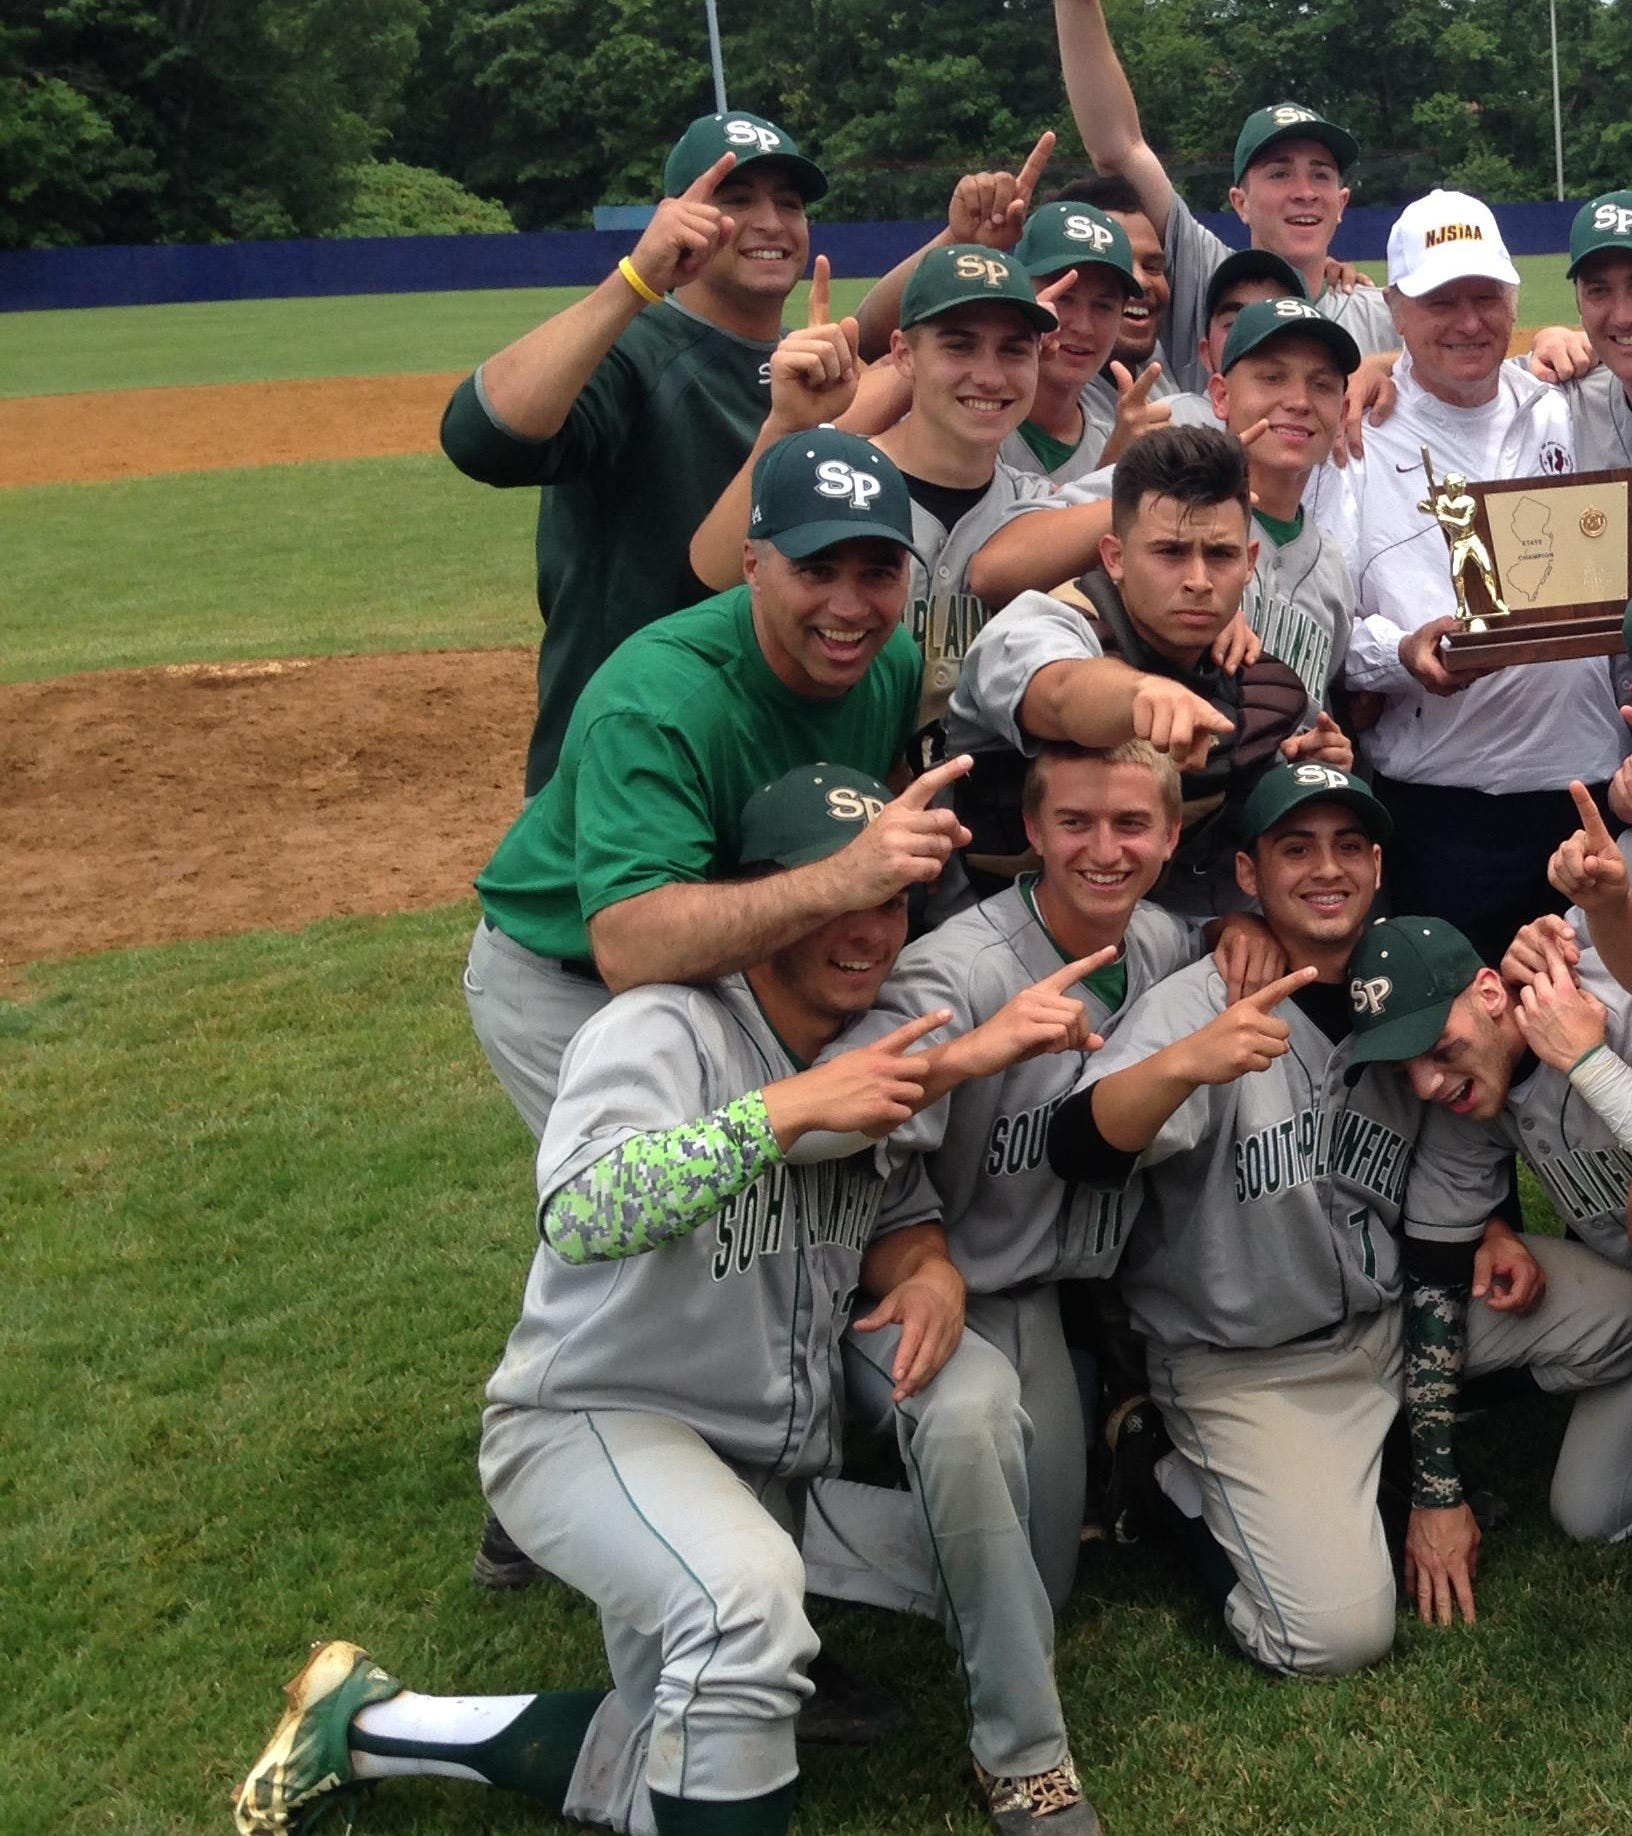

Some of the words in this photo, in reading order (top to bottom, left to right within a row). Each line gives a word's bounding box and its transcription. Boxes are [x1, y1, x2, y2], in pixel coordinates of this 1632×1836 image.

[725, 118, 782, 152] SP
[1064, 214, 1115, 254] SP
[1425, 223, 1483, 249] NJSIAA
[954, 253, 1010, 288] SP
[814, 460, 882, 511] SP
[1294, 763, 1349, 789] SP
[1349, 975, 1393, 1017] SP
[1347, 1206, 1377, 1280] 7
